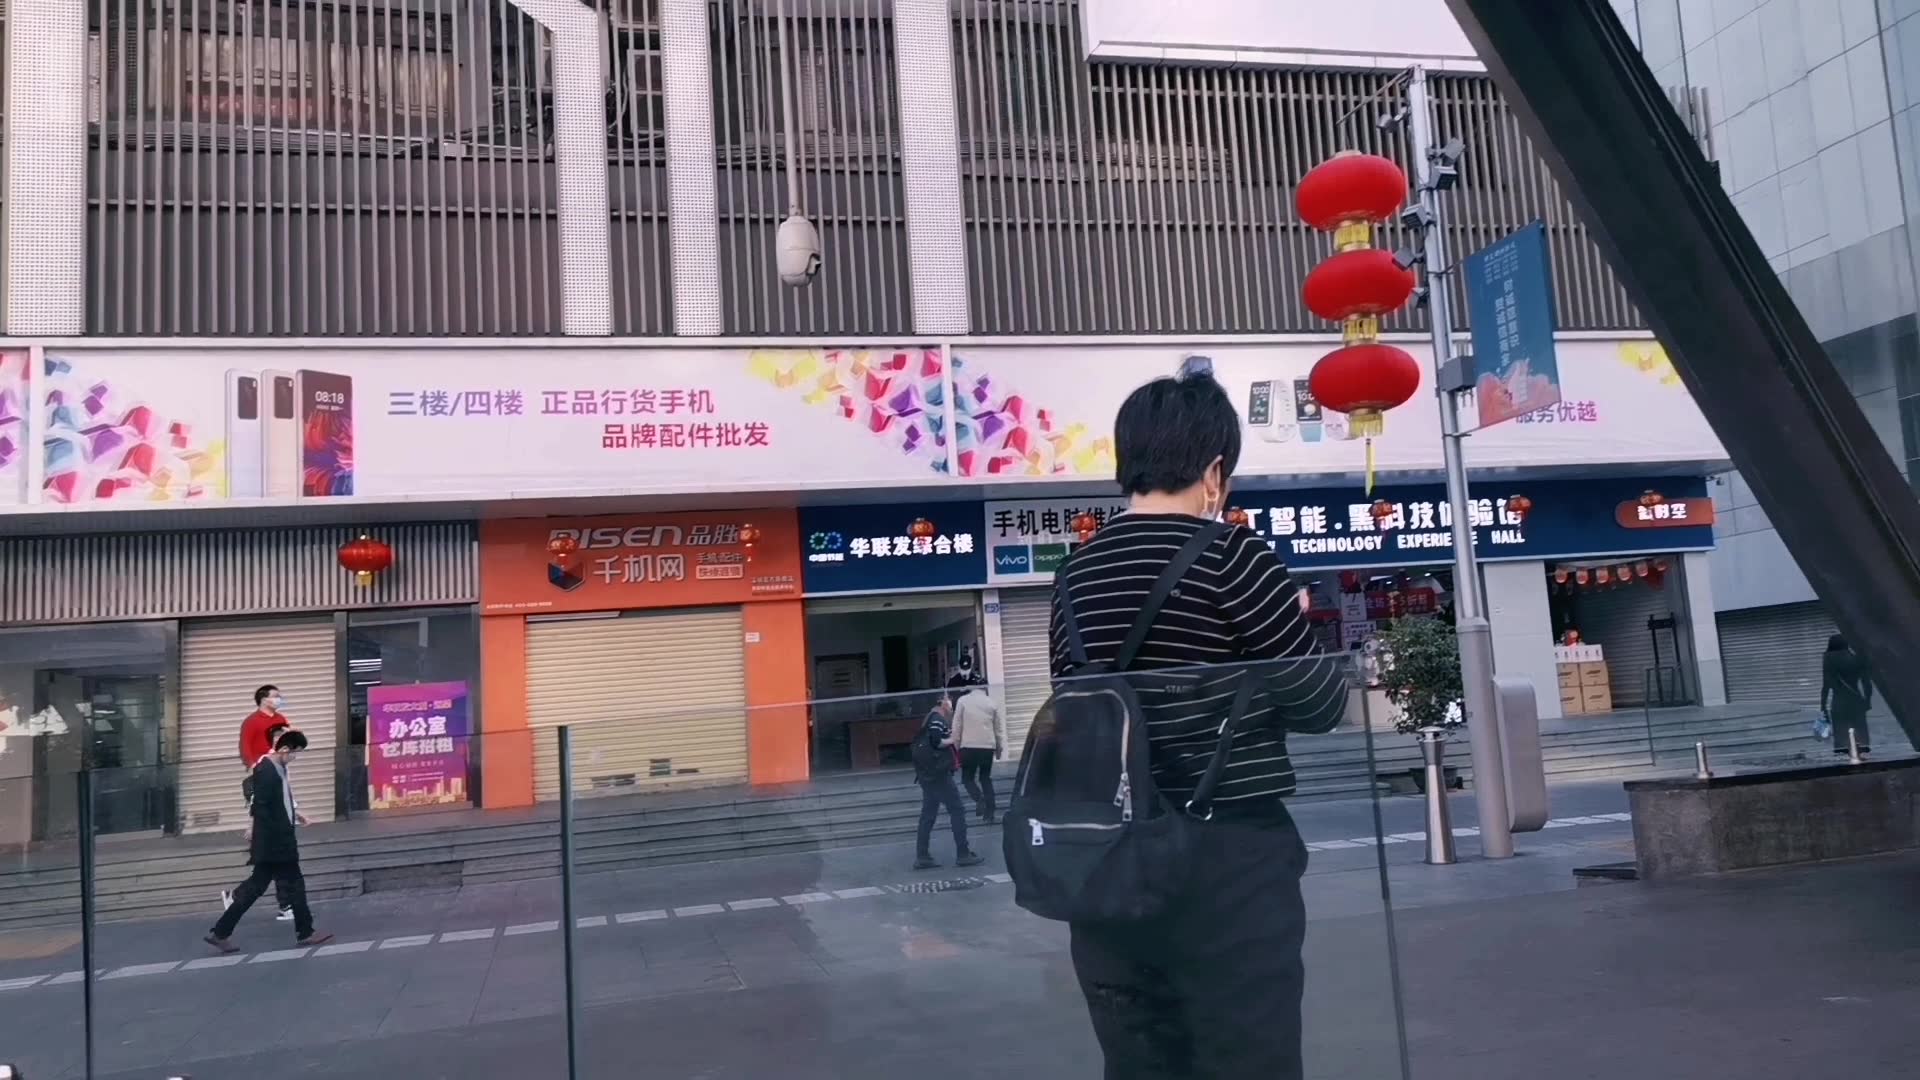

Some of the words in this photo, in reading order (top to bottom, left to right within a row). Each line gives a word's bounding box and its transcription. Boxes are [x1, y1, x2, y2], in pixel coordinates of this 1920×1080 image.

[315, 391, 345, 404] 08:18
[387, 390, 524, 417] 三楼/四楼
[541, 389, 715, 415] 正品行货手机
[1516, 401, 1597, 423] 服务优越
[601, 422, 770, 449] 品牌配件批发
[687, 525, 739, 545] 品胜
[850, 533, 974, 558] 华联发综合楼
[1291, 536, 1382, 554] TECHNOLOGY
[1397, 532, 1478, 548] EXPERIEE
[1491, 529, 1525, 544] HALL
[594, 554, 685, 584] 千机网
[996, 555, 1027, 566] vivo
[389, 715, 446, 739] 办公室
[380, 737, 454, 758] 仓库招租
